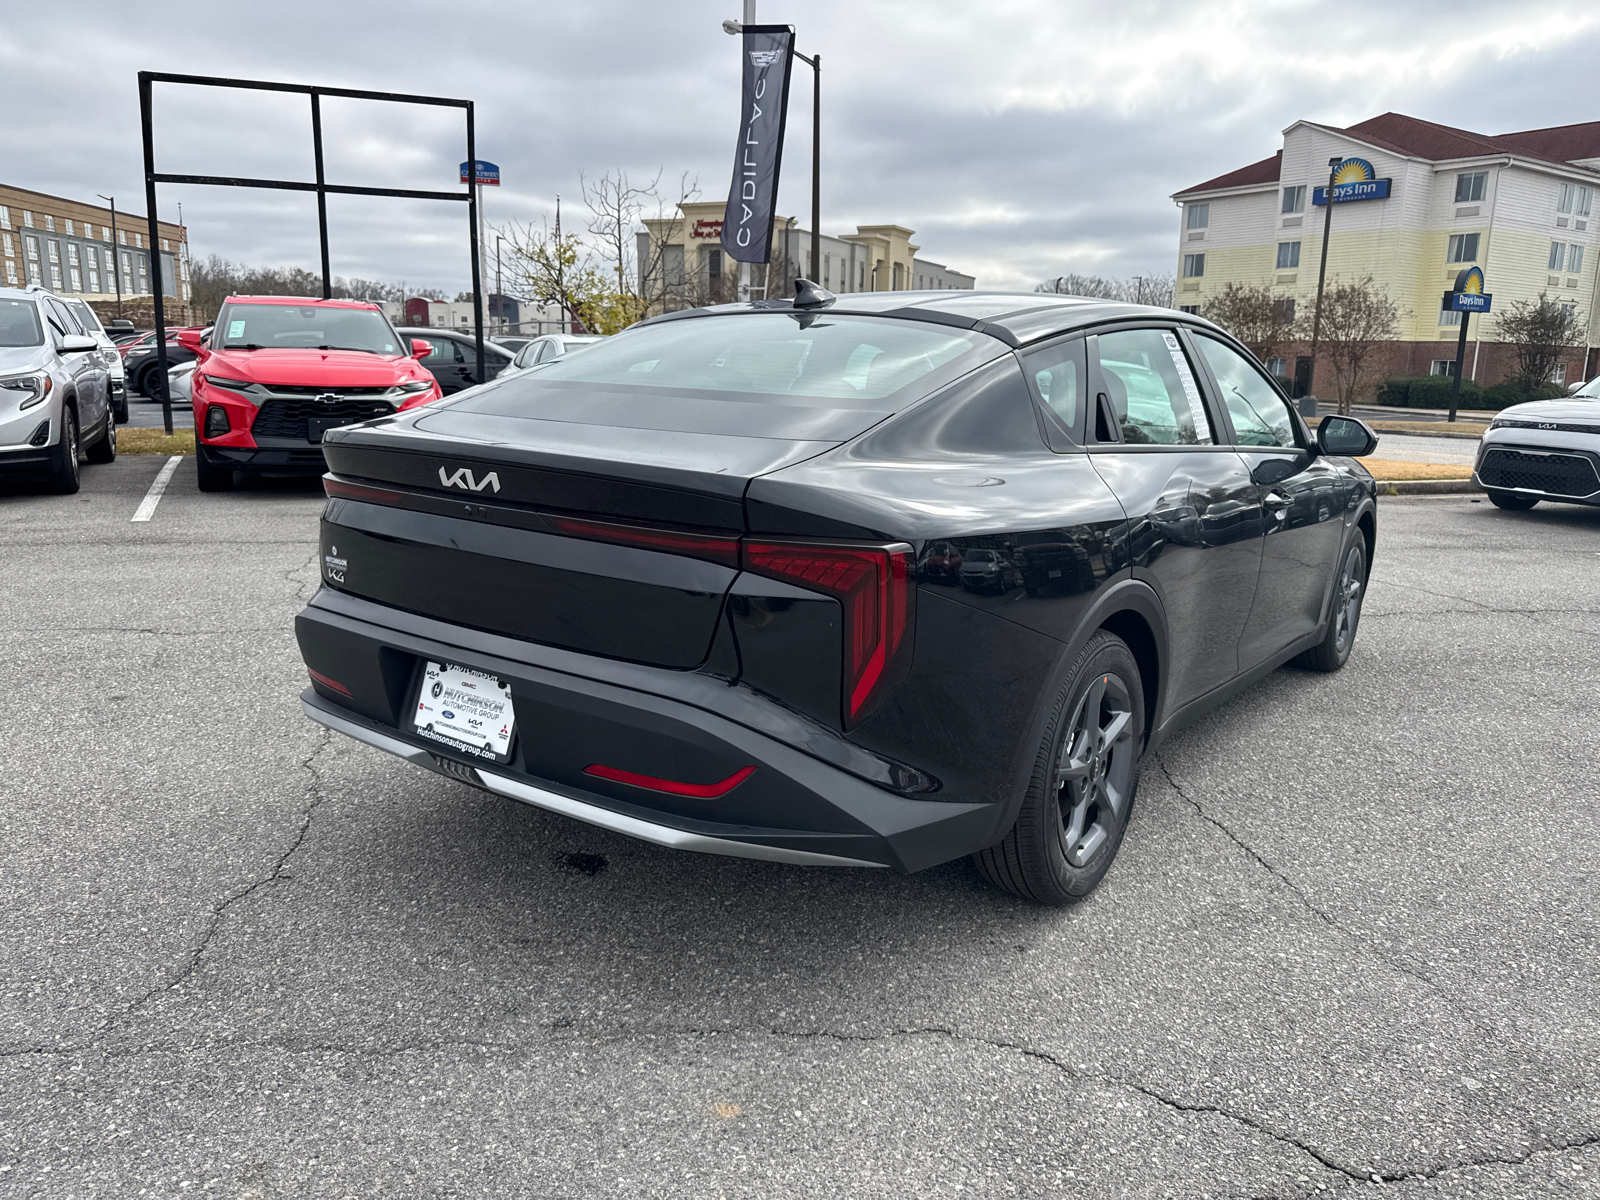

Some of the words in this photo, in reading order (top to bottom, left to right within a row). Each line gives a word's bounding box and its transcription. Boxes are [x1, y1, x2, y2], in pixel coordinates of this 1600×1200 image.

[1355, 183, 1376, 194] Inn
[1459, 294, 1474, 306] Days
[1474, 296, 1484, 306] Inn
[438, 466, 501, 493] KIA
[328, 567, 345, 583] K4
[442, 687, 505, 714] HUTCHINSON
[442, 699, 478, 715] AUTOMOTIVE
[478, 709, 500, 720] GROUP
[416, 727, 496, 760] Hutchinsonautogroup.com
